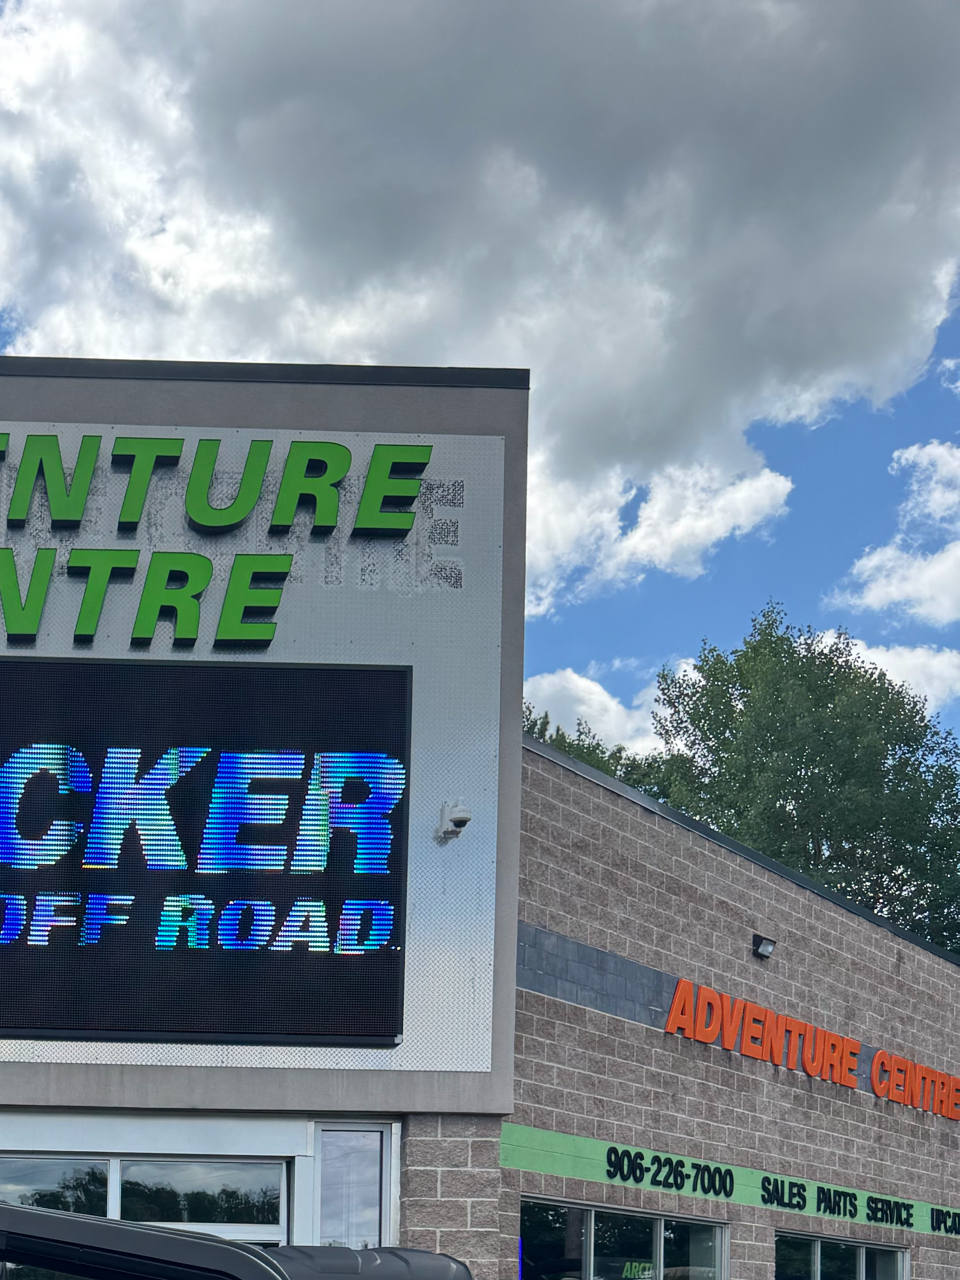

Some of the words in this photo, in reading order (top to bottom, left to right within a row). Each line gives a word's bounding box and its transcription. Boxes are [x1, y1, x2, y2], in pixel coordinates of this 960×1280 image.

[155, 894, 397, 955] ROAD
[665, 978, 861, 1089] ADVENTURE
[871, 1049, 960, 1121] CENTRE
[606, 1146, 734, 1198] 906-226-7000
[761, 1176, 807, 1211] SALES
[816, 1186, 858, 1219] PARTS
[866, 1196, 914, 1228] SERVICE
[930, 1207, 960, 1235] UPCA
